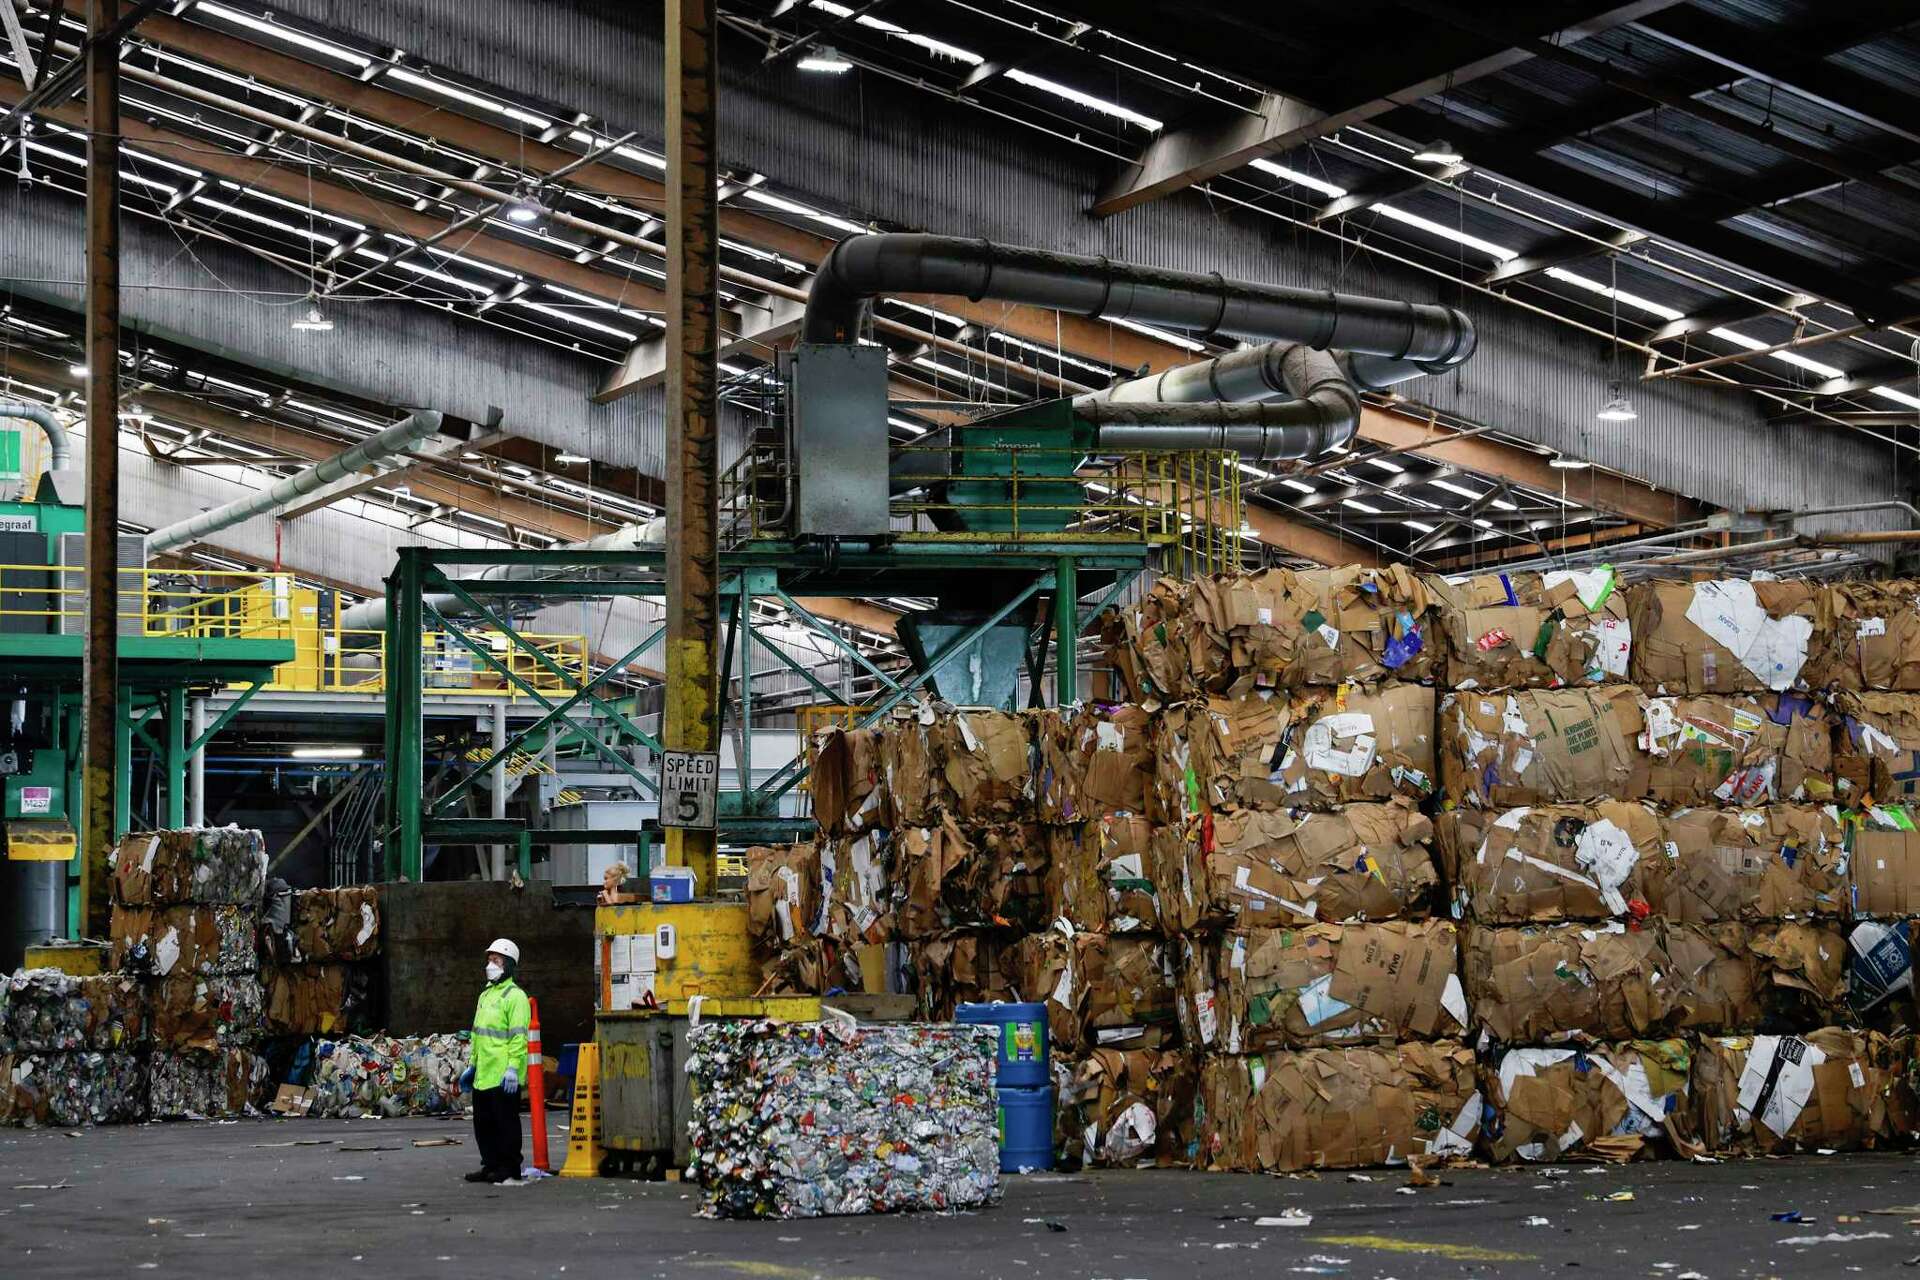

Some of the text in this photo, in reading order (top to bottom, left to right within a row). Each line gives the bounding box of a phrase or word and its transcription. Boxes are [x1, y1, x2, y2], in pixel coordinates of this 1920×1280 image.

[666, 757, 714, 774] SPEED
[668, 776, 709, 792] LIMIT
[678, 791, 700, 822] 5
